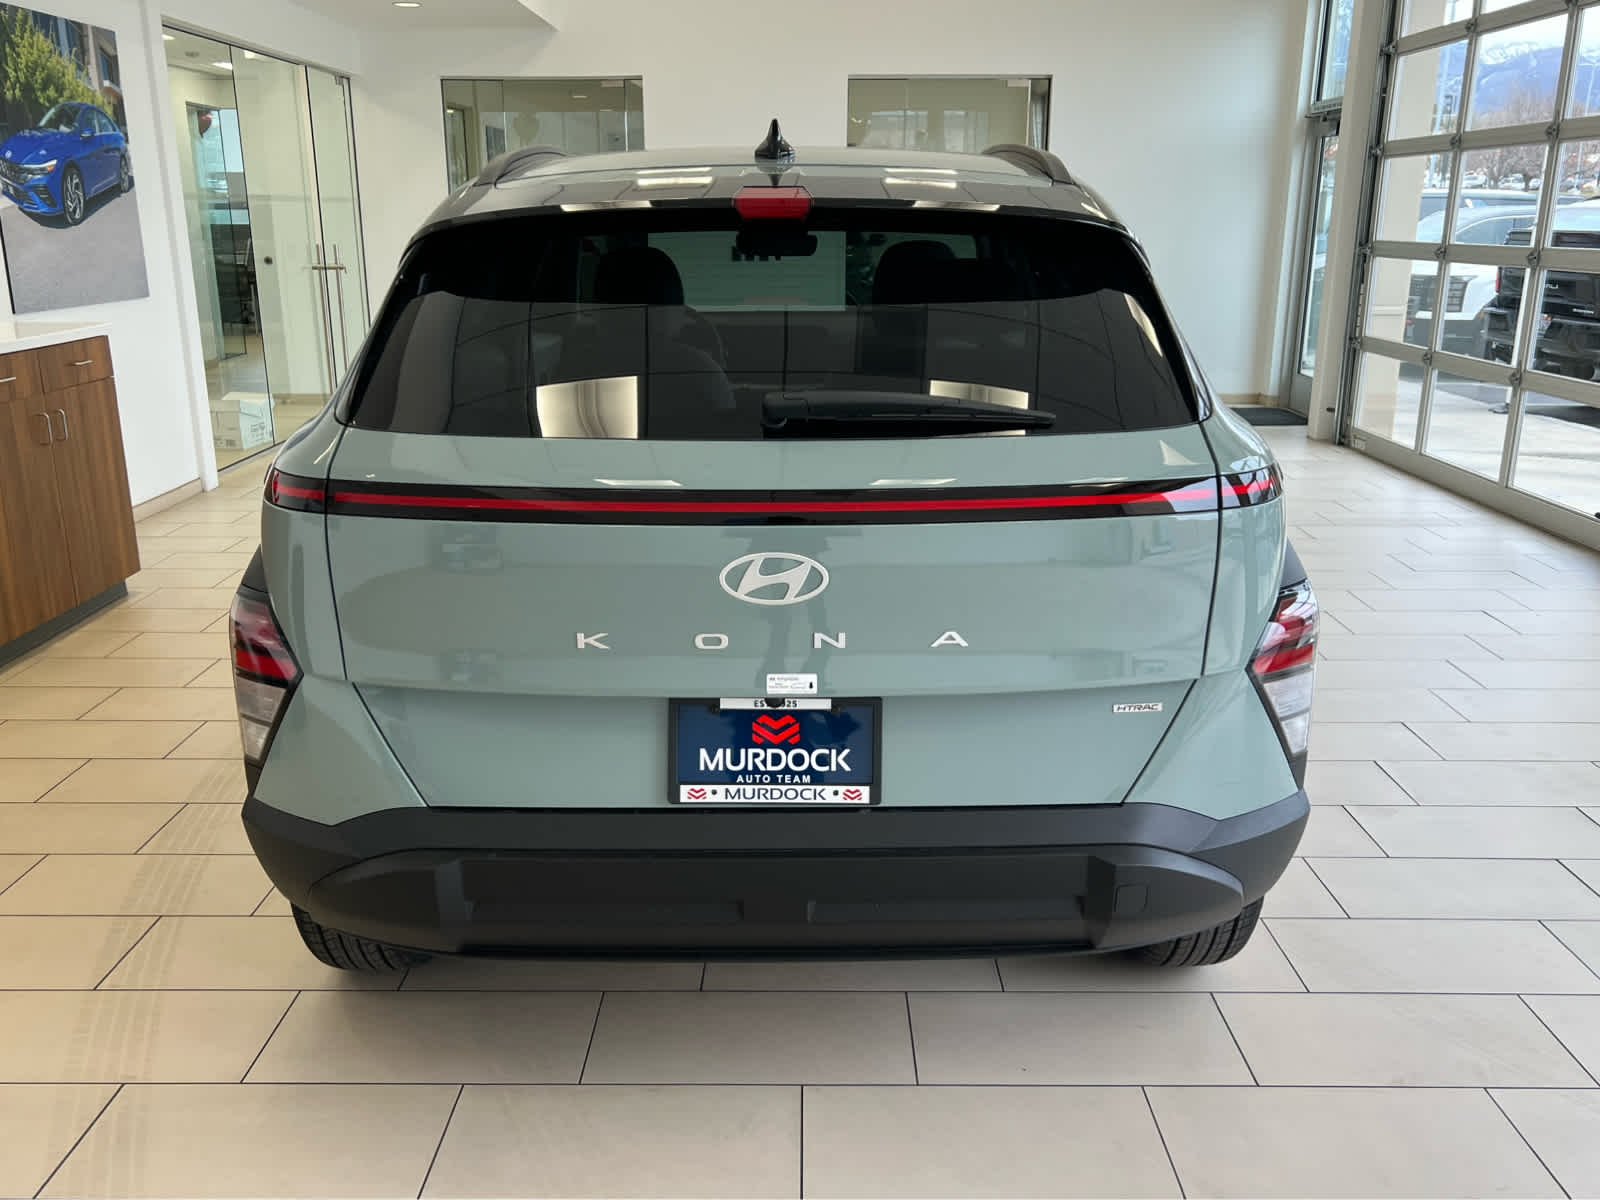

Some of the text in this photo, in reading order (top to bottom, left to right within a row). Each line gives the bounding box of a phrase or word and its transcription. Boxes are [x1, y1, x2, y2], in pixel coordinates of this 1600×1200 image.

[576, 632, 969, 650] KONA
[1116, 703, 1160, 712] HTRAC
[699, 748, 852, 772] MURDOCK
[736, 774, 811, 784] AUTO TEAM
[724, 788, 827, 801] MURDOCK
